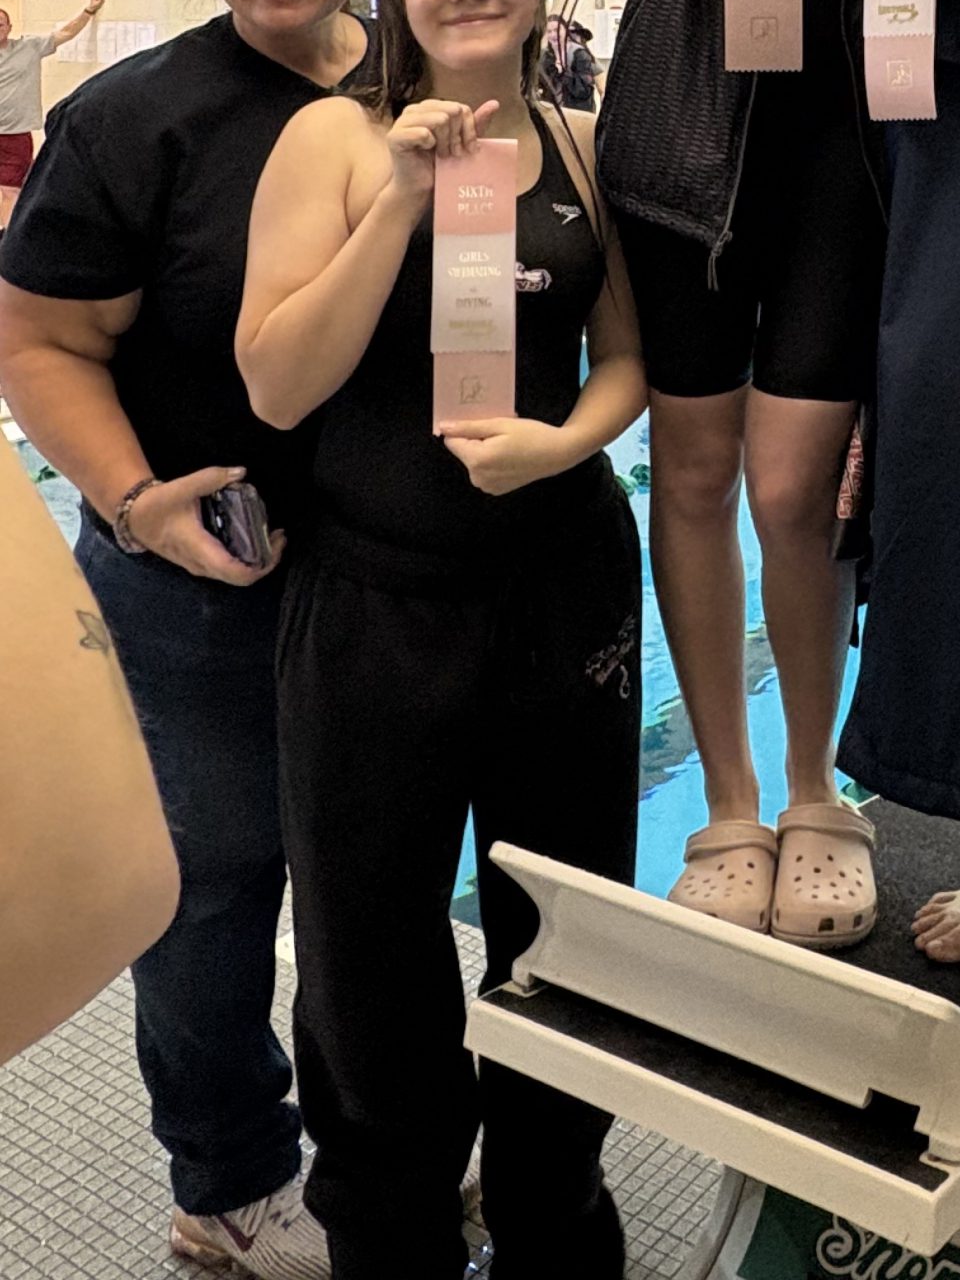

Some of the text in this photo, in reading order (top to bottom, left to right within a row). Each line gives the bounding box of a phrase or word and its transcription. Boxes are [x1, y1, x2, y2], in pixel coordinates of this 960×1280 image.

[457, 184, 494, 199] SIXTH
[459, 251, 490, 262] GIRLS
[455, 297, 493, 309] DIVING
